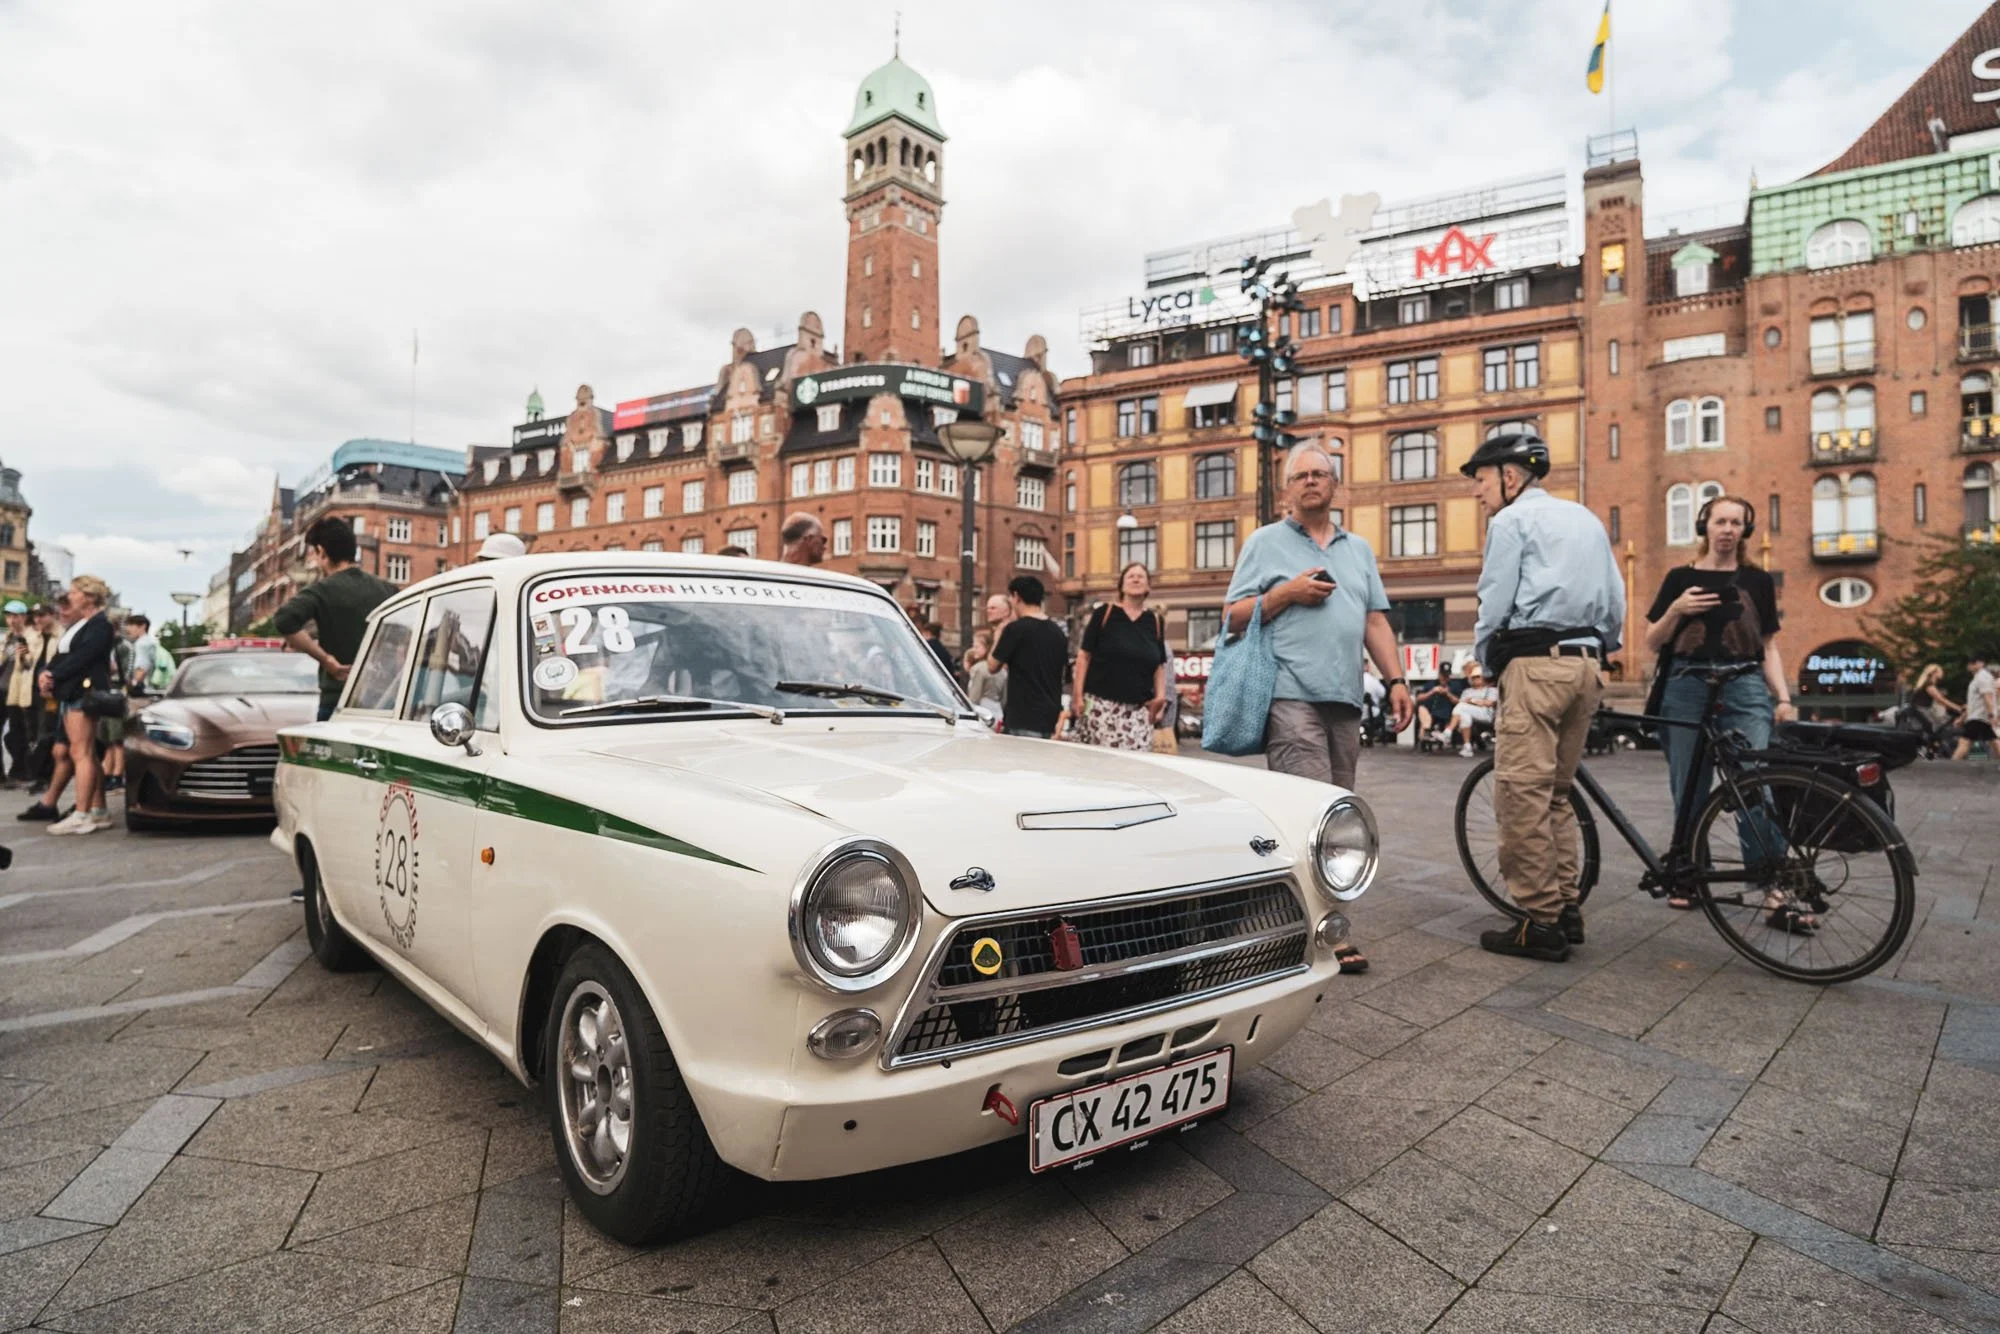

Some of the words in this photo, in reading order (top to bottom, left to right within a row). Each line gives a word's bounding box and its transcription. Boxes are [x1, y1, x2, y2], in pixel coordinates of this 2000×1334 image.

[1415, 225, 1498, 280] MAX
[1129, 289, 1193, 323] Lyca
[535, 584, 676, 603] COPENHAGEN
[680, 585, 800, 600] HISTORIC
[559, 606, 636, 653] 28
[1806, 655, 1866, 670] Believe
[1818, 673, 1838, 684] or
[385, 829, 407, 897] 28
[1052, 1097, 1101, 1151] CX
[1111, 1083, 1151, 1131] 42
[1161, 1062, 1217, 1115] 475
